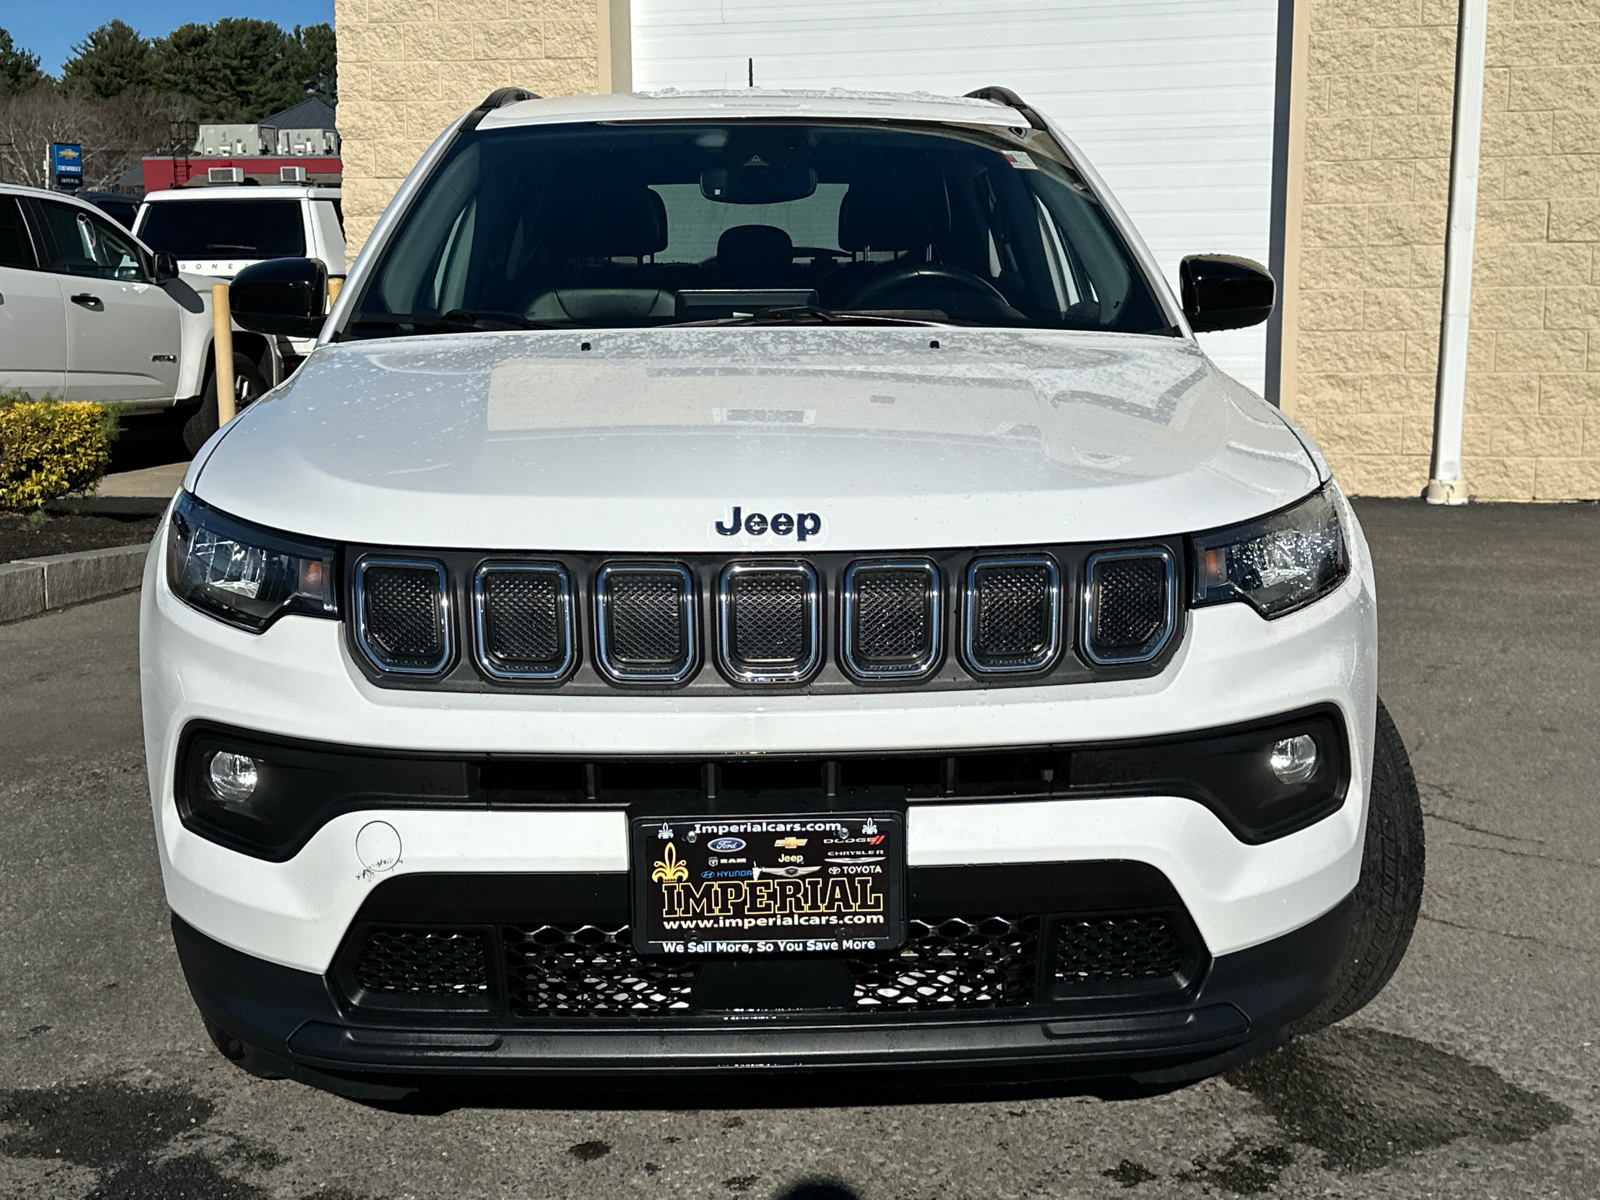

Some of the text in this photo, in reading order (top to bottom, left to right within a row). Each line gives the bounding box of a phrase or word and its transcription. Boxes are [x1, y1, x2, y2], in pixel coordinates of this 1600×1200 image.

[715, 506, 821, 542] Jeep
[694, 821, 841, 835] Imperialcars.com
[716, 840, 738, 850] Ford
[778, 853, 804, 864] Jeep
[716, 869, 753, 877] HYUNDA
[842, 865, 882, 874] TOYOTA
[662, 877, 883, 918] IMPERIAL
[663, 914, 884, 930] www.imperialcars.com
[663, 939, 876, 954] We Sell More, So You Save More
